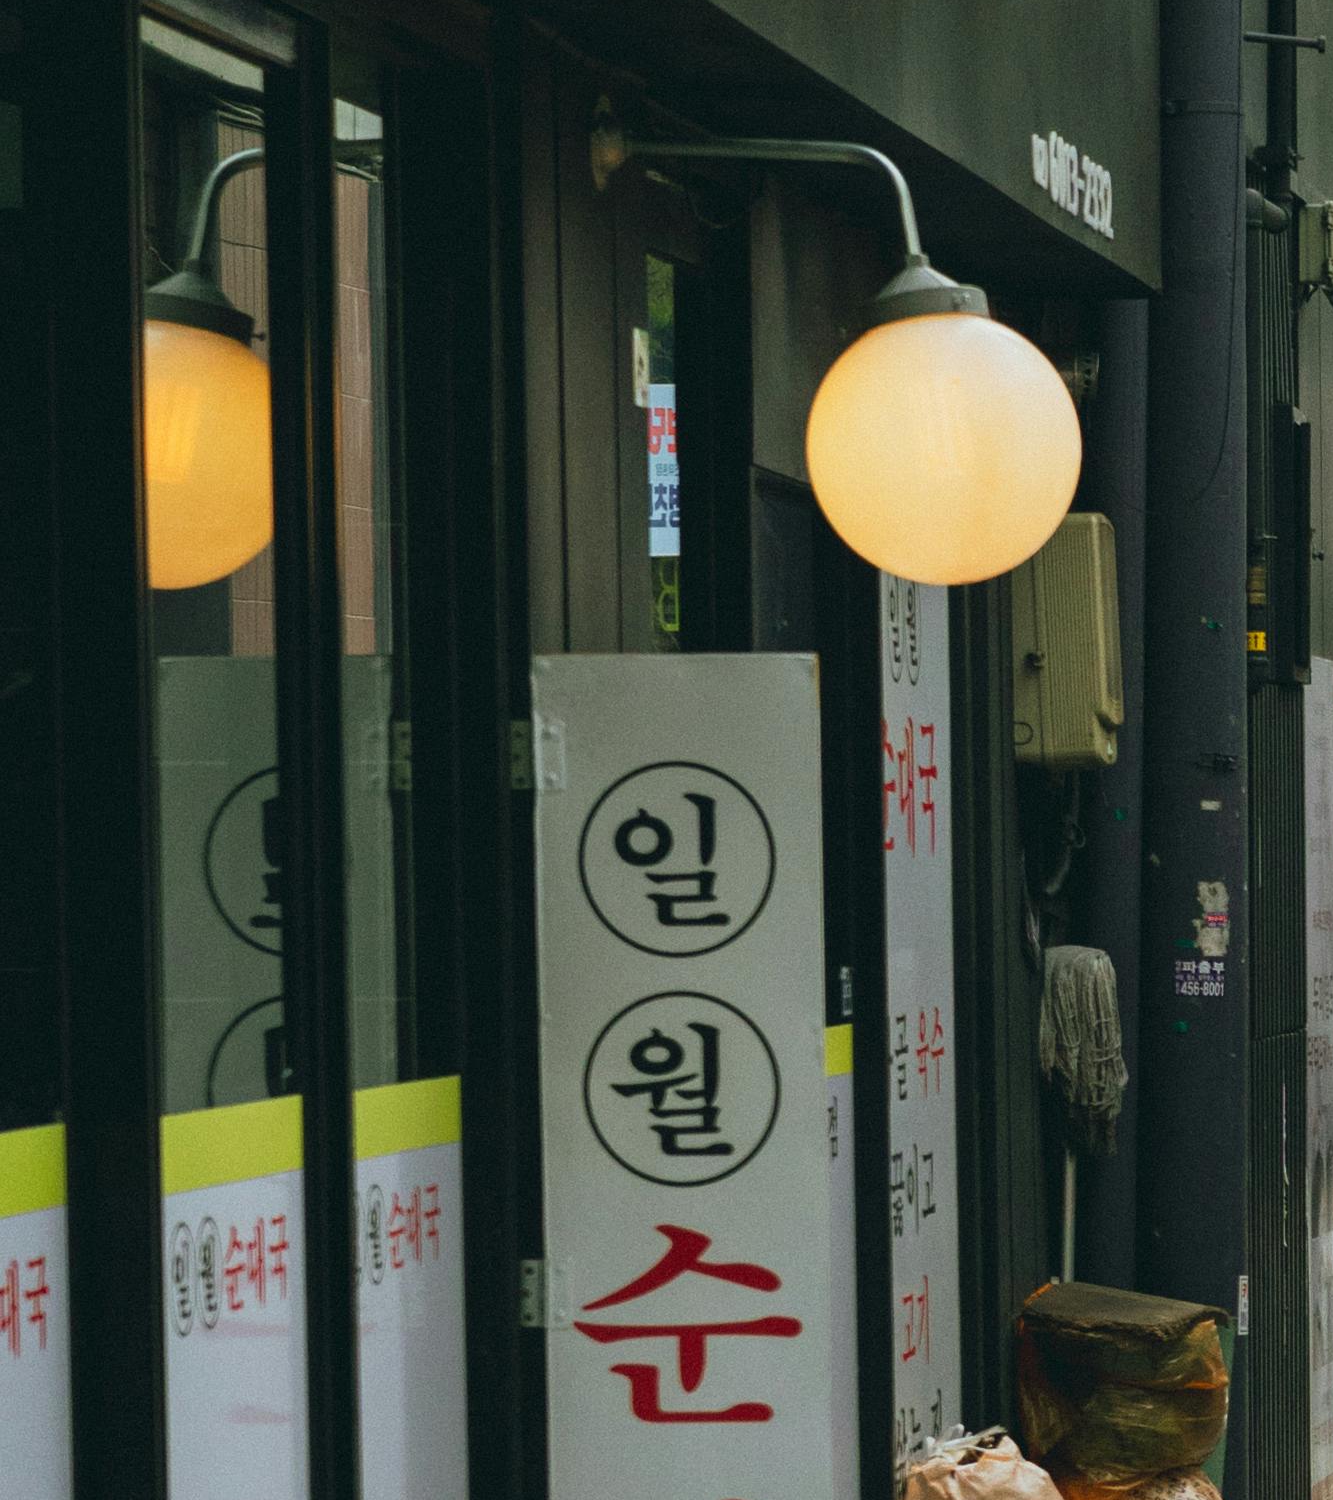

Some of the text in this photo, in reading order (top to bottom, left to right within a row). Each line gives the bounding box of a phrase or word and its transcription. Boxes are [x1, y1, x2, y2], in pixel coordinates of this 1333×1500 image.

[225, 1213, 289, 1312] 순대국
[388, 1184, 441, 1271] 순대국
[902, 1275, 930, 1365] 고기
